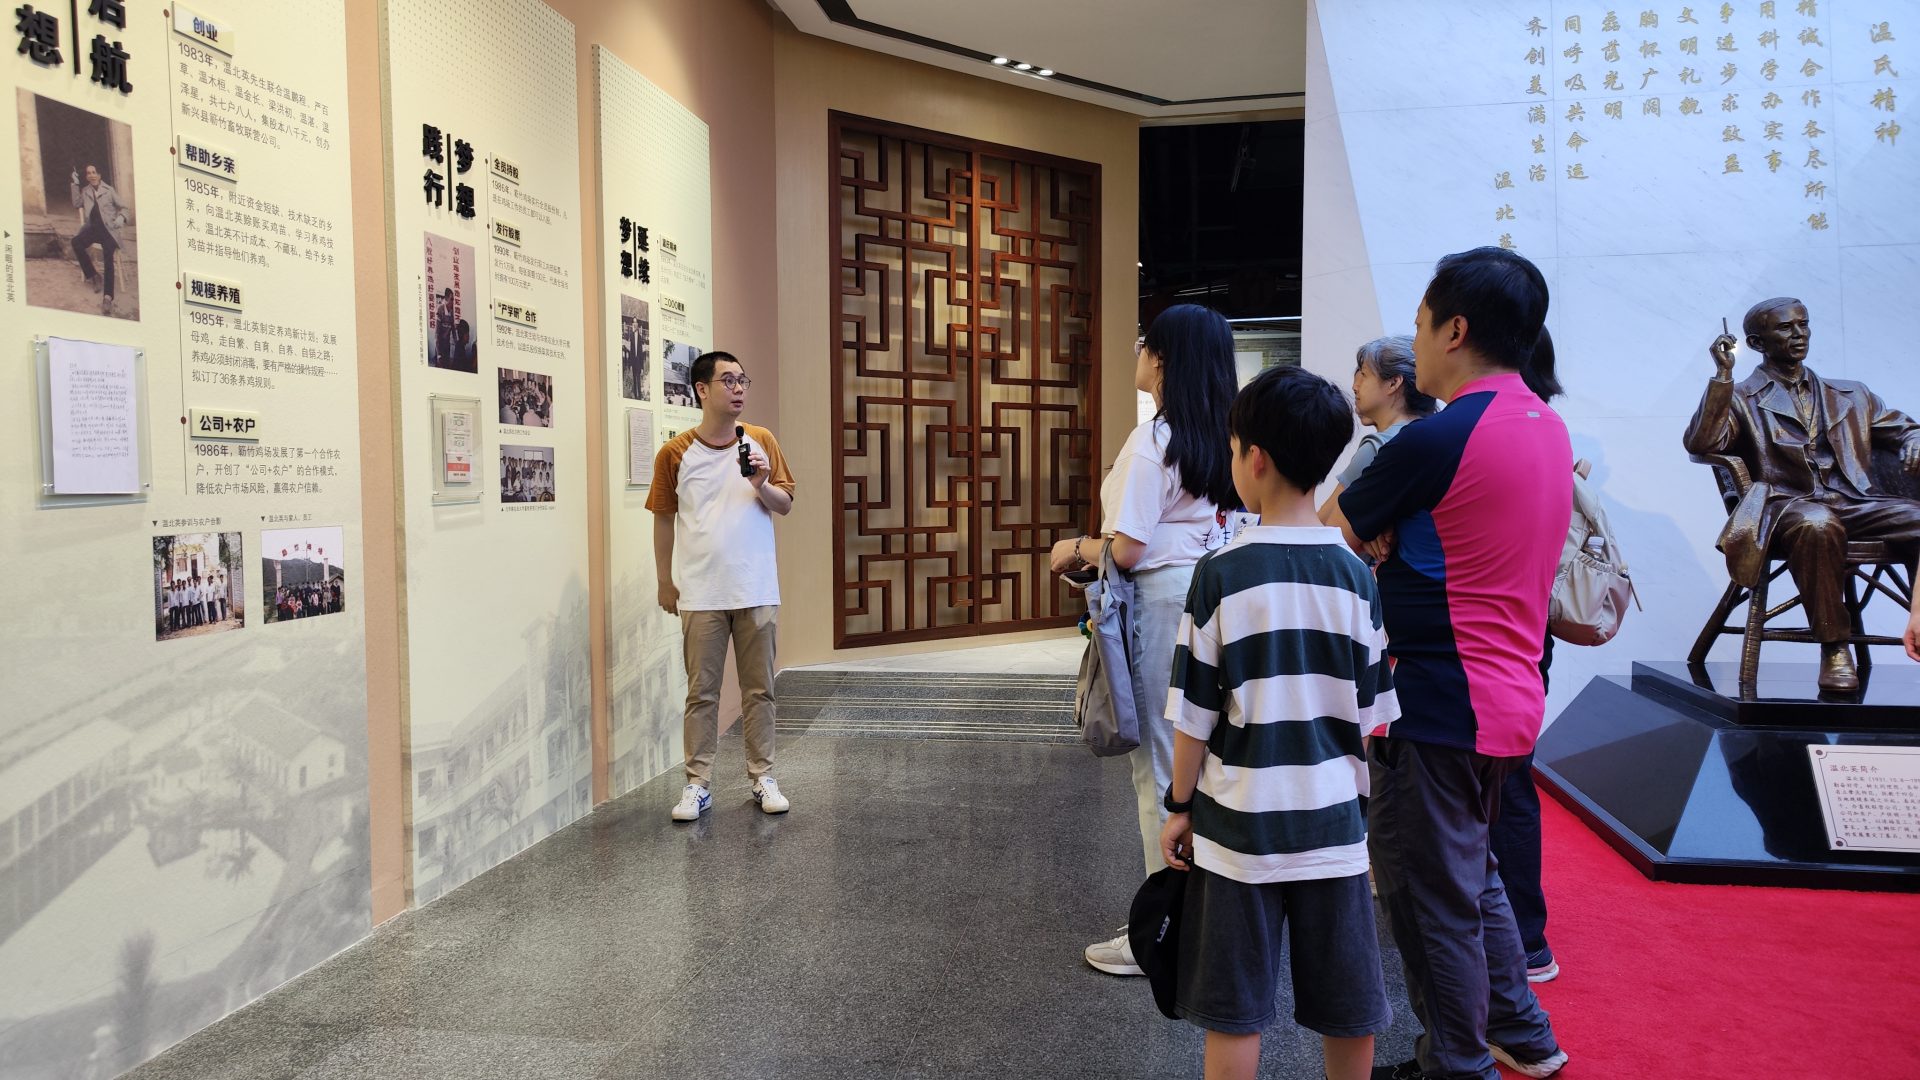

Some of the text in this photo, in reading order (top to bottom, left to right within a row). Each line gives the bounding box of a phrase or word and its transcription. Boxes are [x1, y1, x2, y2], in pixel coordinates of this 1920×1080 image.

[193, 16, 218, 43] 创业
[1869, 21, 1901, 147] 温氏精神
[185, 143, 235, 175] 帮助乡亲
[422, 123, 445, 208] 践行
[494, 158, 519, 179] 全员持股
[454, 139, 476, 220] 梦想
[496, 222, 520, 242] 发行股票
[620, 216, 633, 278] 梦想
[191, 279, 241, 305] 规模养殖
[199, 415, 256, 433] 公司+农户
